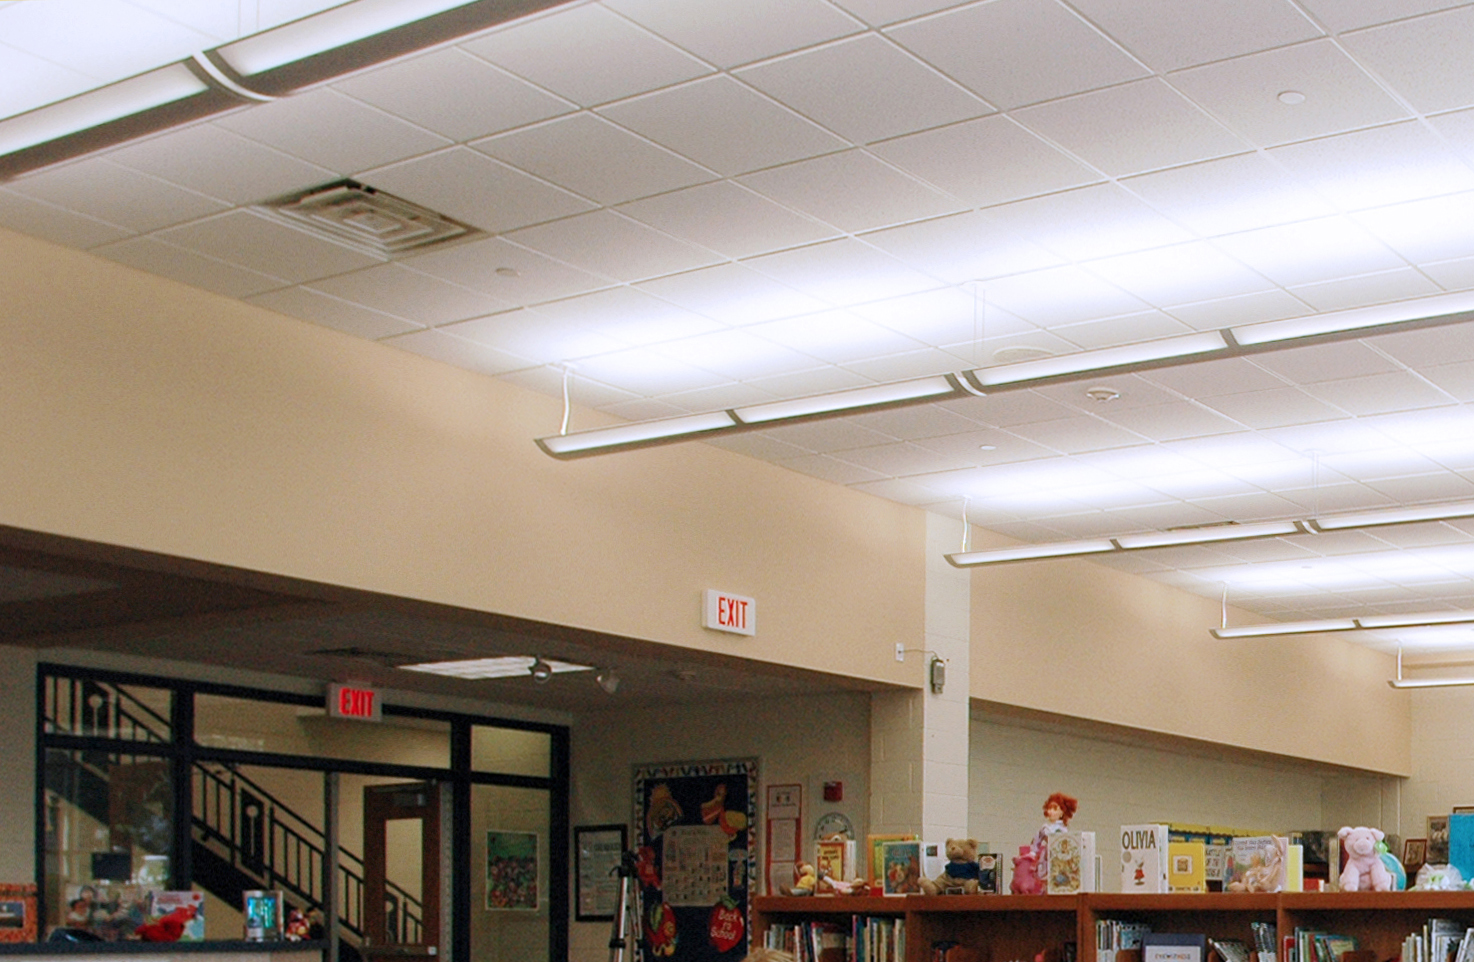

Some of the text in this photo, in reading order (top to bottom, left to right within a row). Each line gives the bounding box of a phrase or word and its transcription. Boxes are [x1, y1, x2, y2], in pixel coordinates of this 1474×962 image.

[717, 596, 748, 629] EXIT
[338, 686, 375, 718] EXIT
[1121, 829, 1157, 850] OLIVIA
[718, 908, 738, 922] Back
[710, 929, 736, 941] School
